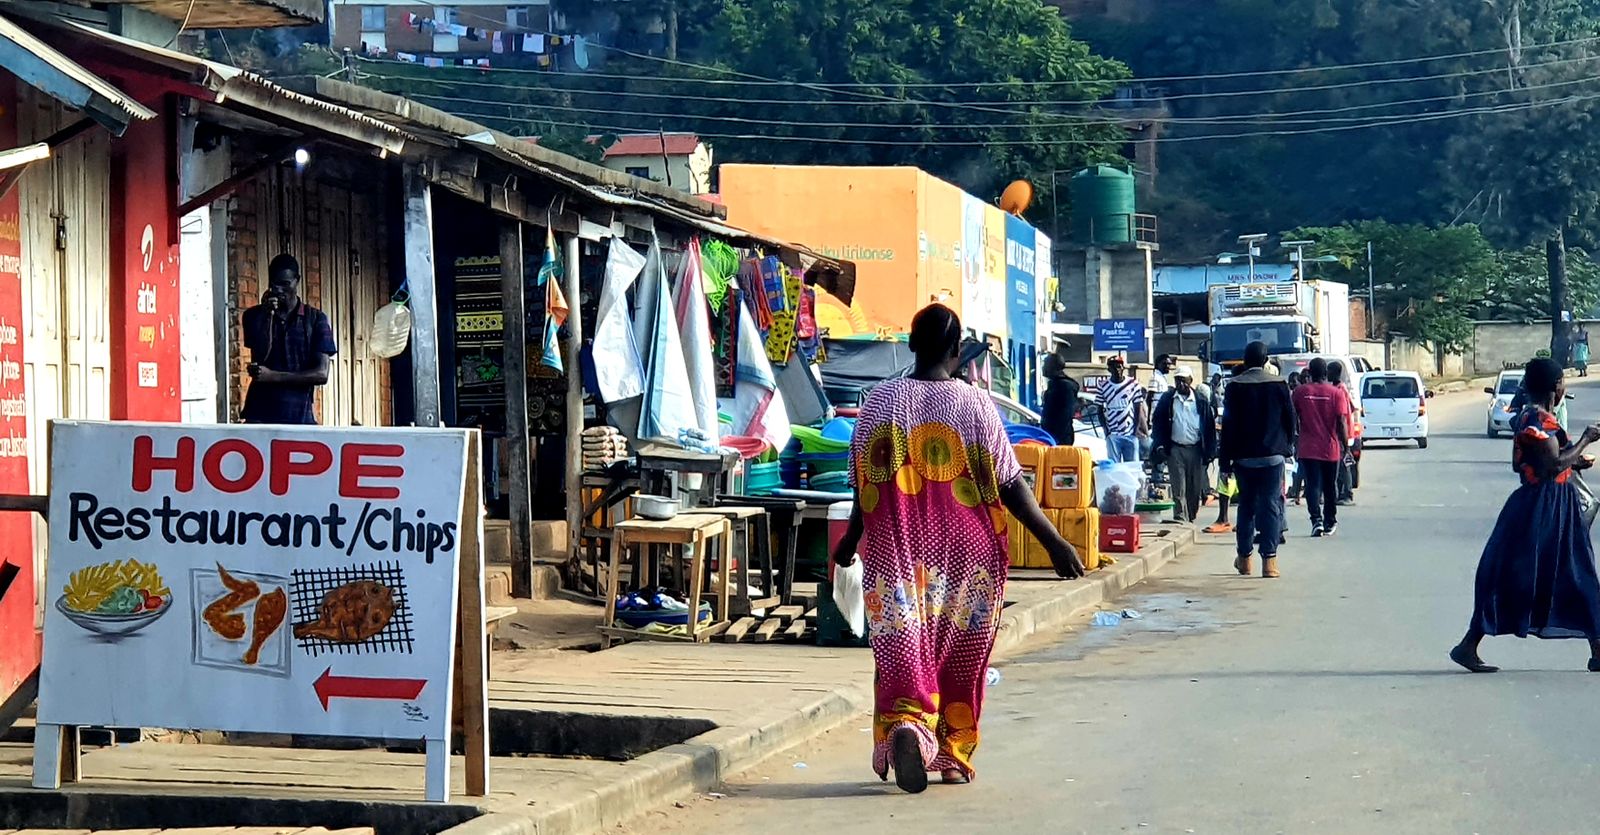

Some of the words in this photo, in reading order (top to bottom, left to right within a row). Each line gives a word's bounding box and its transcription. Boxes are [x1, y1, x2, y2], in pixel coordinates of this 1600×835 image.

[138, 282, 156, 313] airtel
[131, 435, 405, 499] HOPE
[68, 492, 457, 564] Restaurant/Chips
